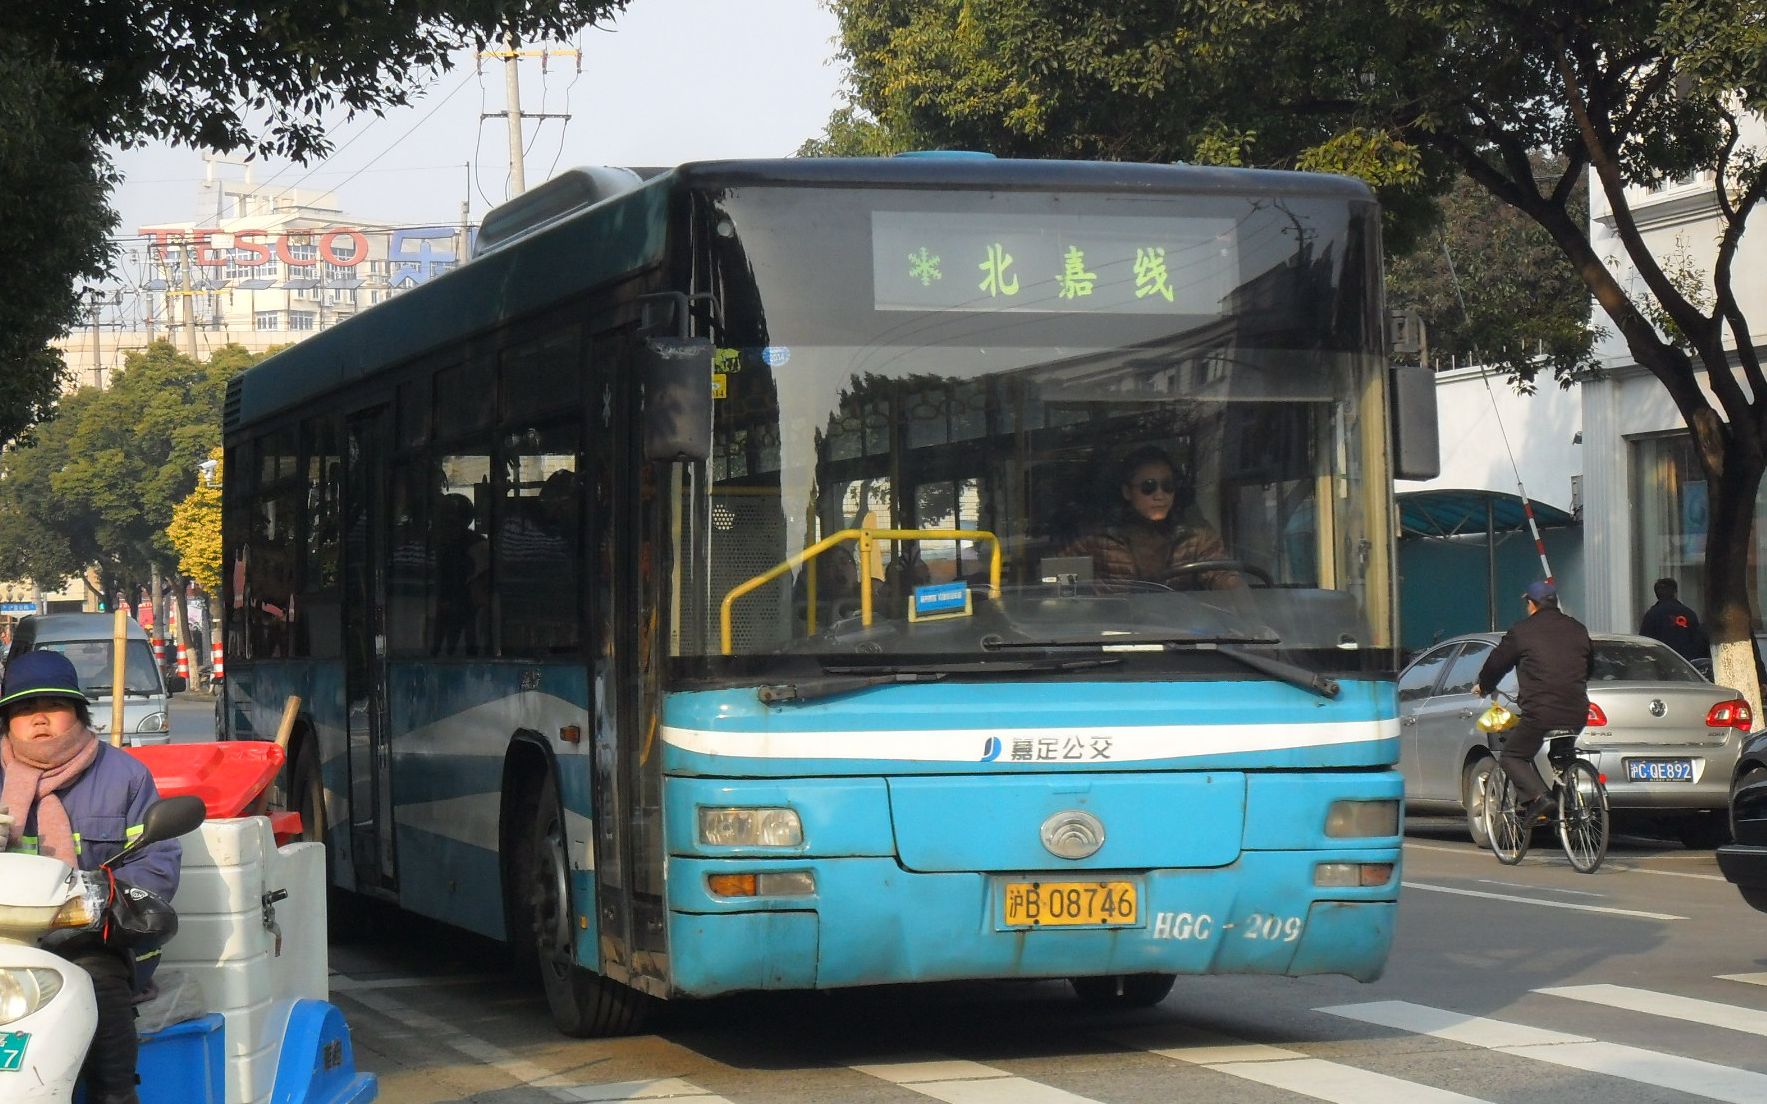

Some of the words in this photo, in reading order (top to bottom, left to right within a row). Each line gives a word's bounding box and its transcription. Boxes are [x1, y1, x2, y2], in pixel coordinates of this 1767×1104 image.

[138, 226, 369, 267] TESCO
[389, 228, 478, 287] 乐
[978, 243, 1174, 301] 北嘉线
[1011, 735, 1112, 761] 嘉定公交
[1153, 912, 1212, 940] HGC
[1243, 913, 1302, 942] 209
